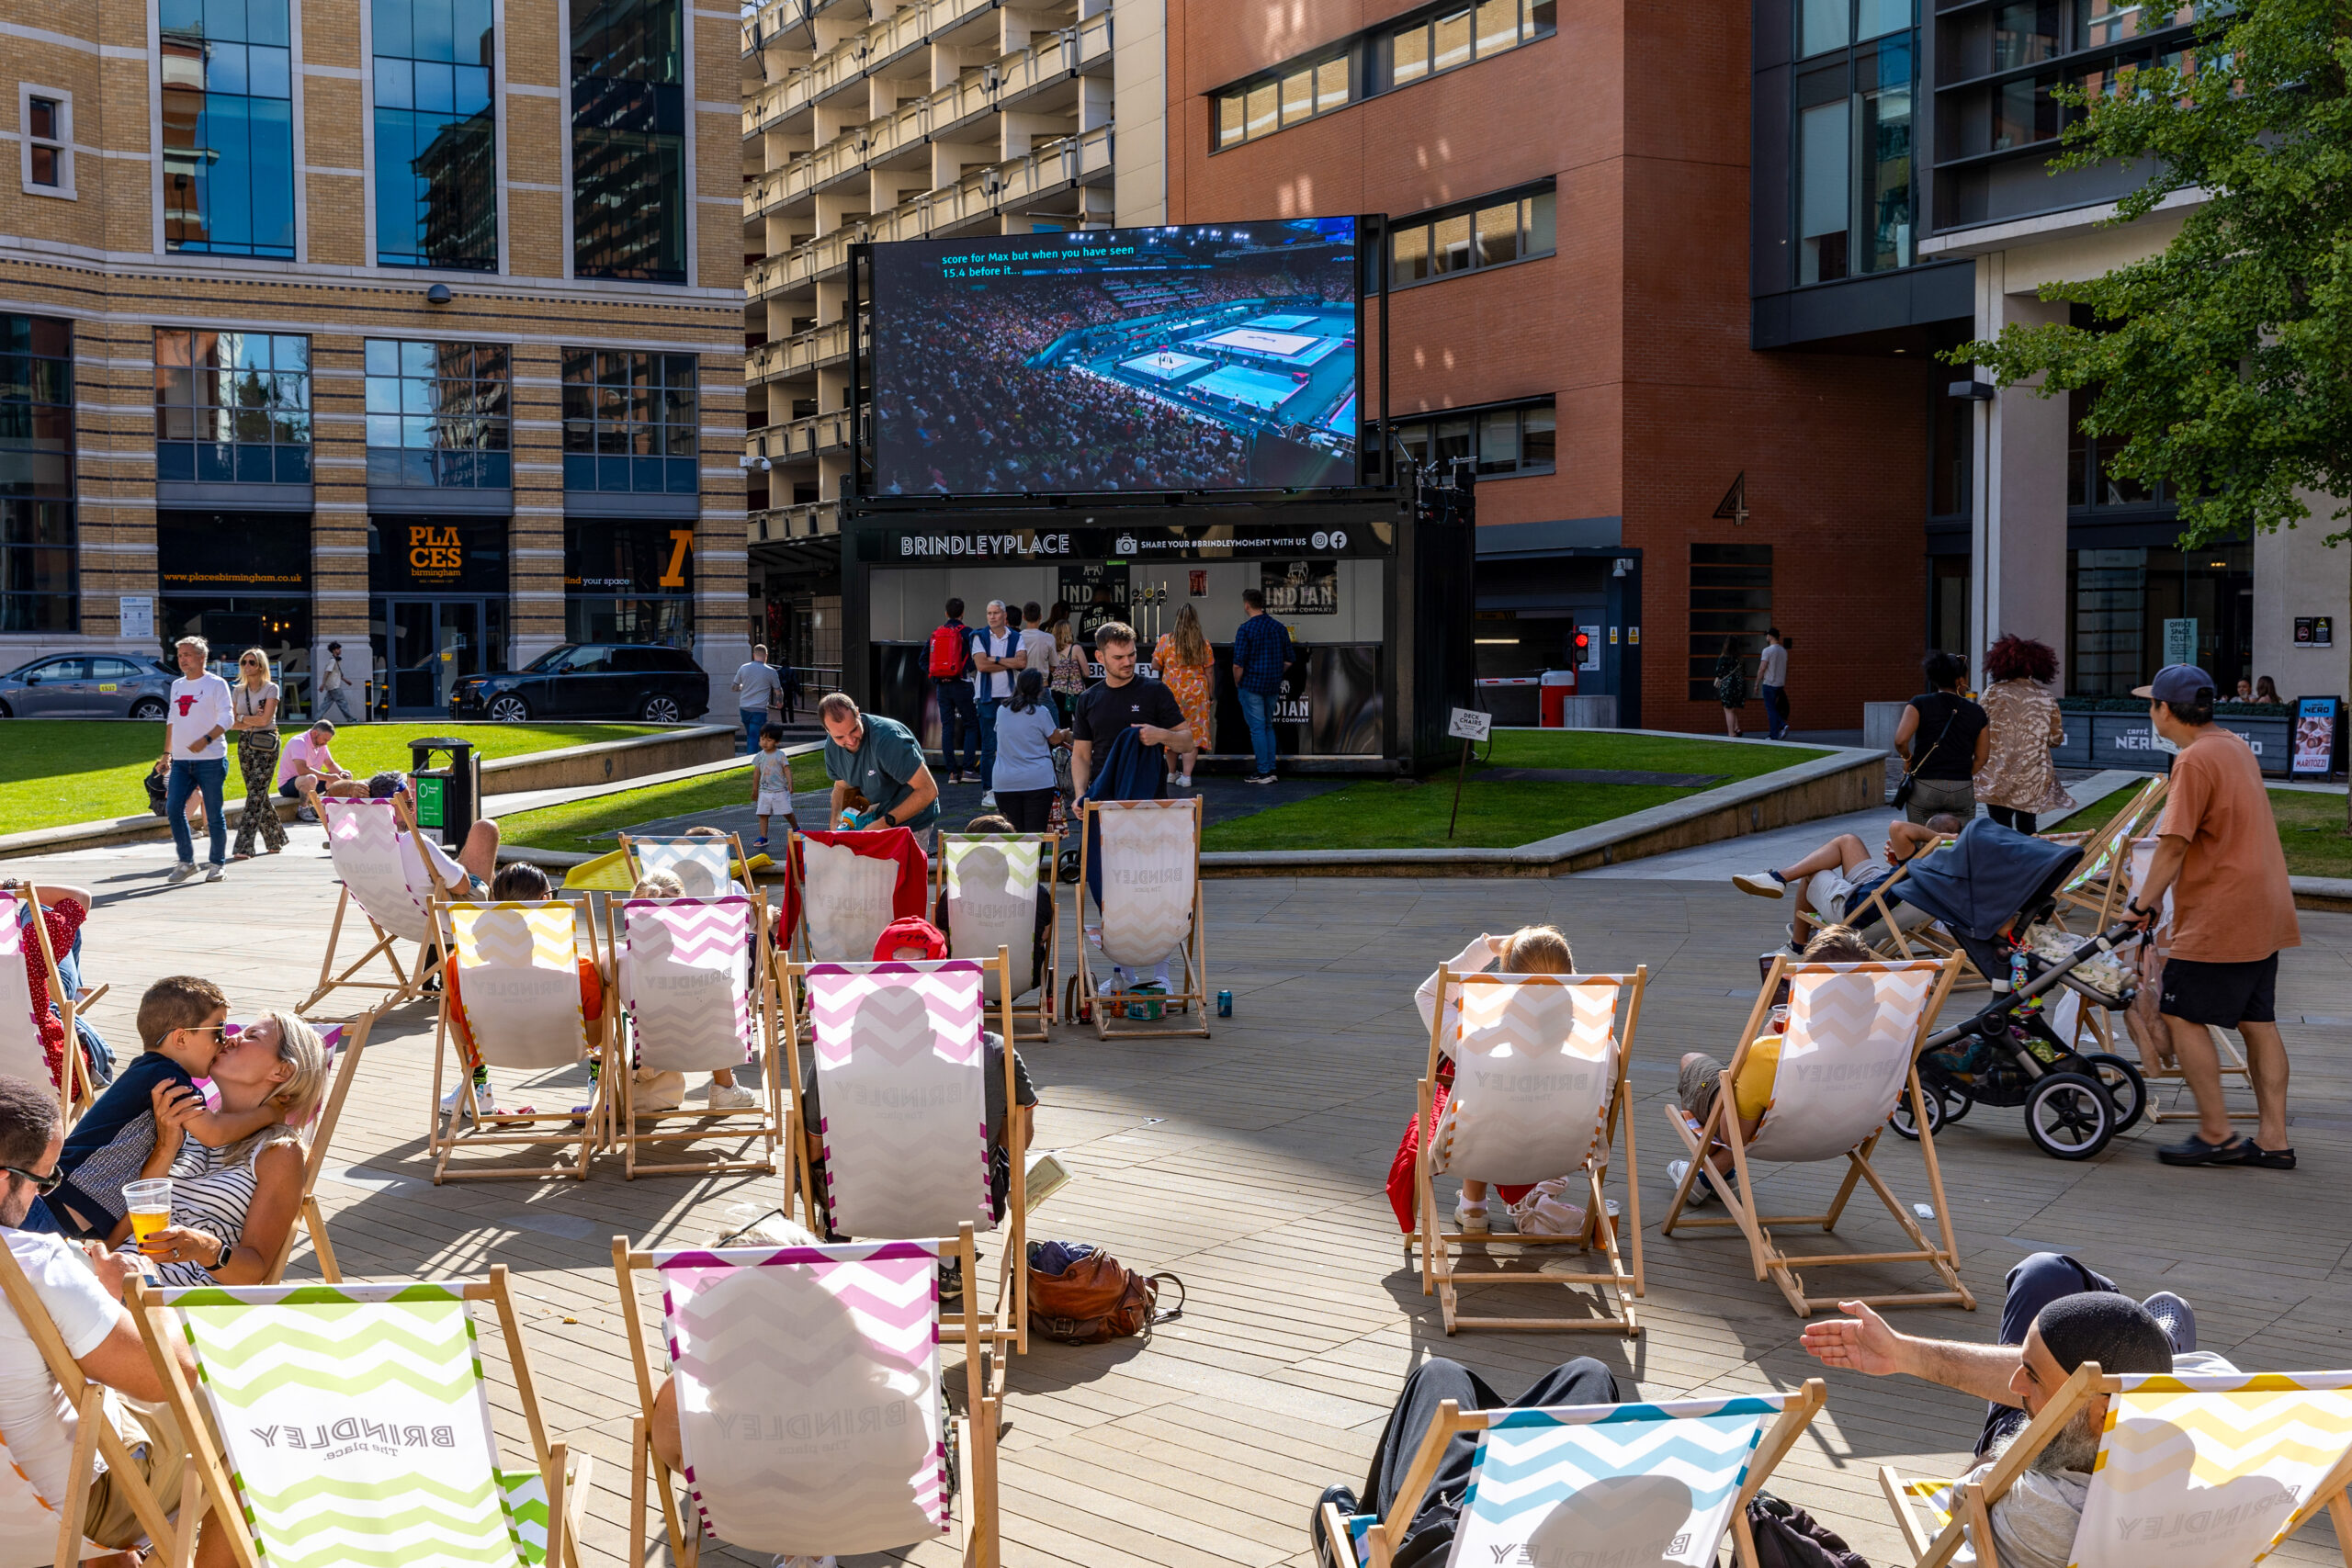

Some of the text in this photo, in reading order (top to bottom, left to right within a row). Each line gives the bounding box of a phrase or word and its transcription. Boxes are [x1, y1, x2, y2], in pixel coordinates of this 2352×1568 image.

[942, 246, 1134, 265] score for Max but when you have seen
[943, 267, 966, 278] 15.4
[969, 266, 1001, 276] before
[1713, 469, 1749, 526] 4
[409, 526, 461, 546] PLA
[1140, 537, 1306, 548] SHARE YOUR #BRINDLEYMOMENT WITH US
[900, 534, 1069, 556] BRINDLEYPLACE
[410, 547, 462, 568] CES
[164, 572, 301, 583] www.placesbirmingham.co.uk
[582, 578, 602, 586] your
[604, 578, 629, 587] space
[1062, 584, 1125, 603] INDN
[1266, 586, 1332, 605] INDIAN
[1089, 664, 1153, 677] BREY
[1272, 701, 1309, 716] DIAN
[1459, 717, 1482, 726] CHAIRS
